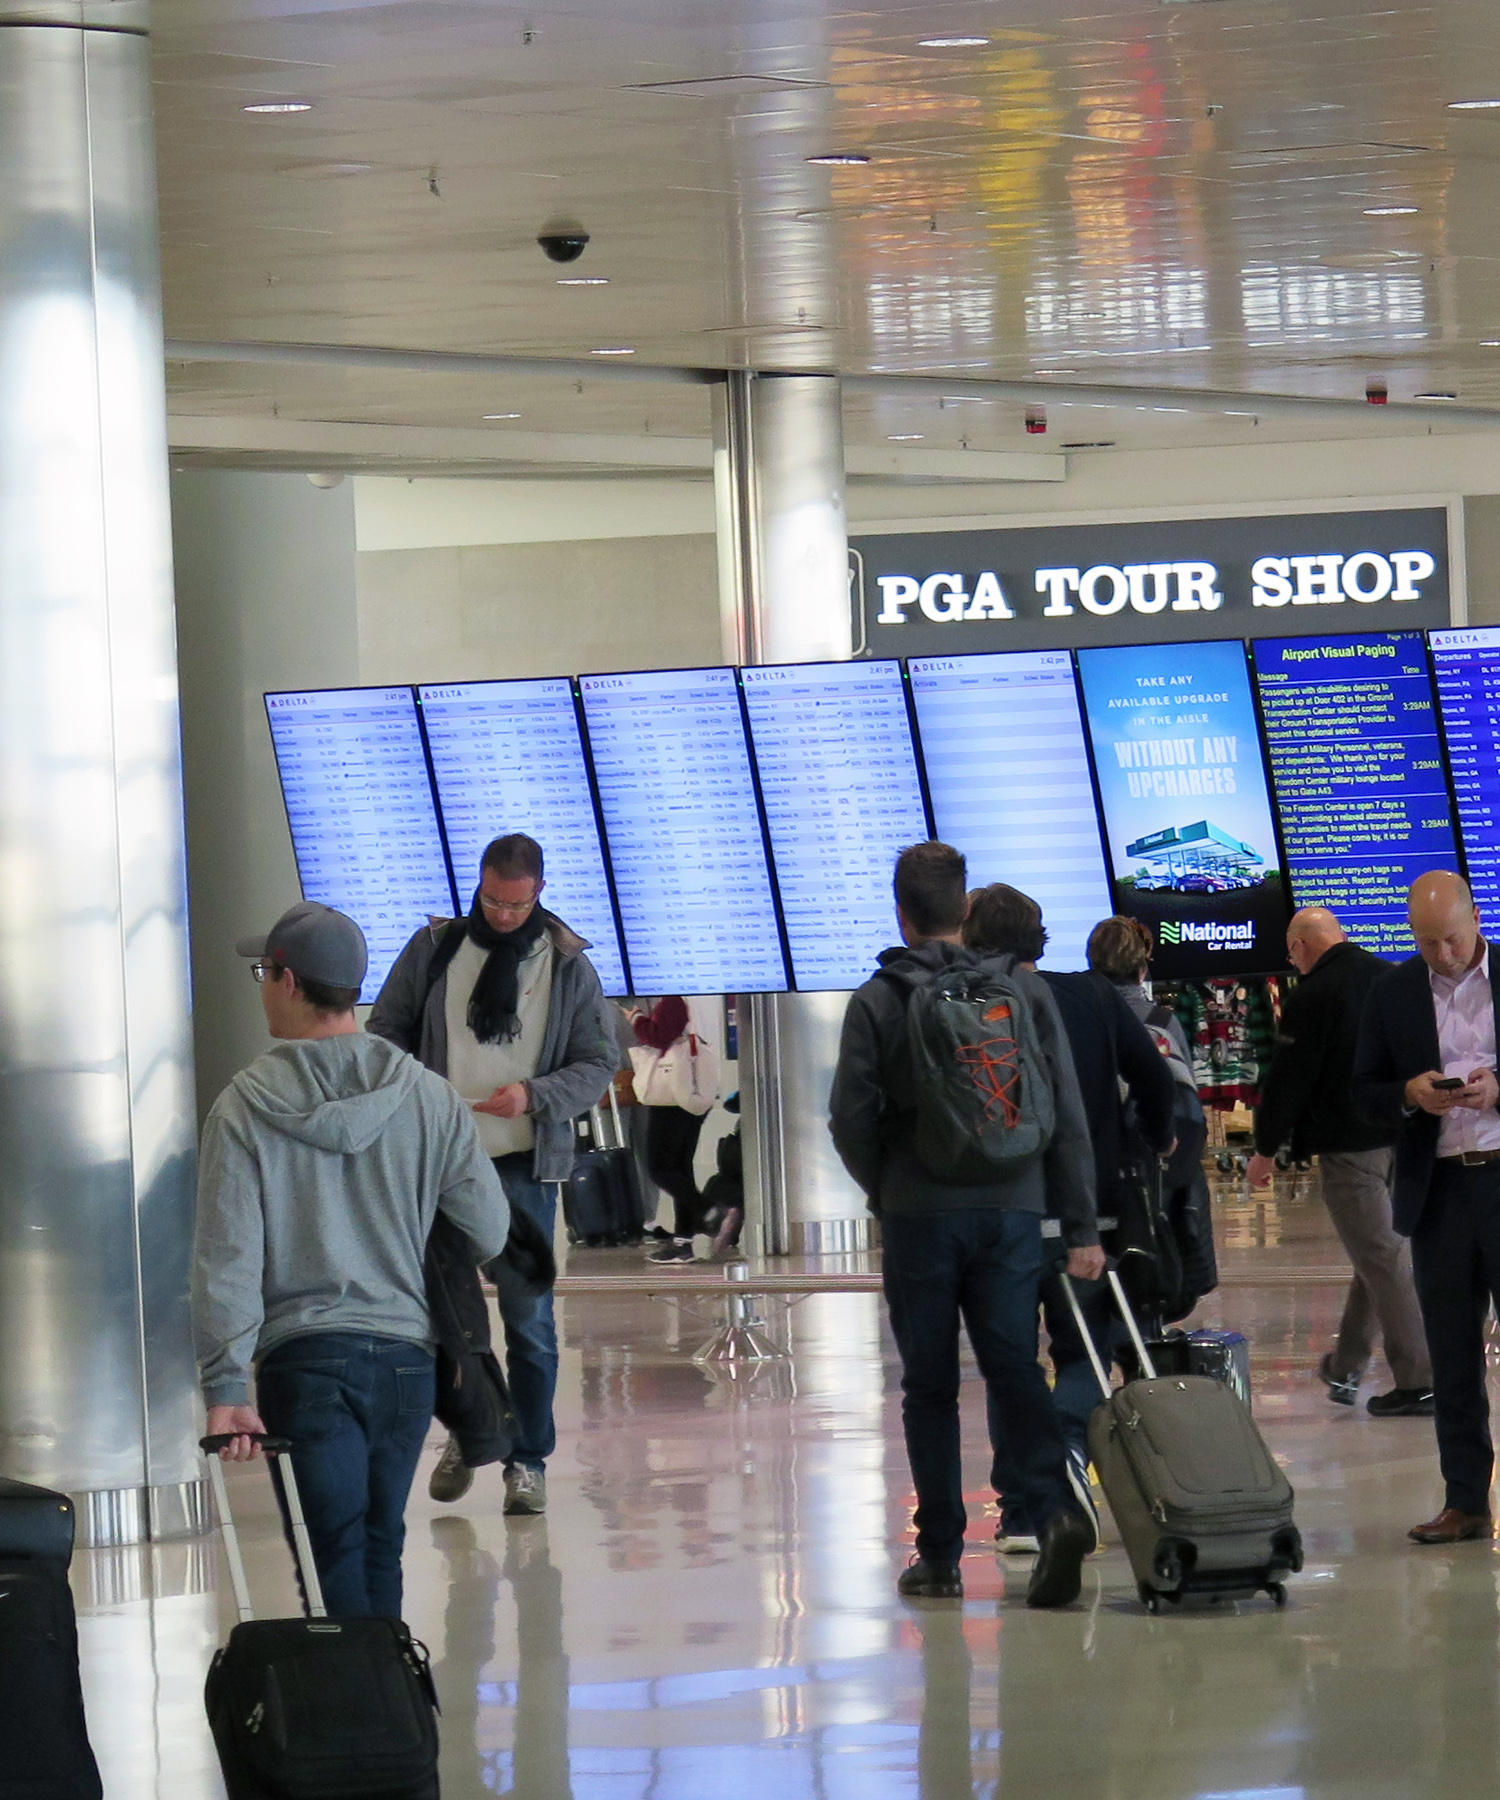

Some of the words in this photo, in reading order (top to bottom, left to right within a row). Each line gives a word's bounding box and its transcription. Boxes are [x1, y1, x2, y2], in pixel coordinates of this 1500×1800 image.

[876, 572, 1015, 624] PGA
[1035, 561, 1224, 617] TOUR
[1251, 550, 1436, 607] SHOP
[1445, 634, 1479, 644] DELTA
[1281, 648, 1320, 661] Airport
[1322, 646, 1354, 658] Visual
[1357, 644, 1396, 658] Paging
[1435, 653, 1471, 662] Departures
[922, 662, 954, 671] DELTA
[755, 672, 787, 681] DELTA
[1136, 677, 1166, 687] TAKE
[1170, 675, 1193, 685] ANY
[594, 679, 624, 689] DELTA
[432, 690, 462, 699] DELTA
[1107, 696, 1170, 709] AVAILABLE
[1174, 693, 1229, 704] UPGRADE
[1133, 717, 1145, 726] IN
[1150, 715, 1172, 725] THE
[1176, 713, 1209, 724] AISLE
[1113, 738, 1197, 768] WITHOUT
[1203, 736, 1238, 763] ANY
[1127, 767, 1237, 798] UPCHARGES
[1207, 942, 1223, 950] Car
[1224, 941, 1252, 950] Rental
